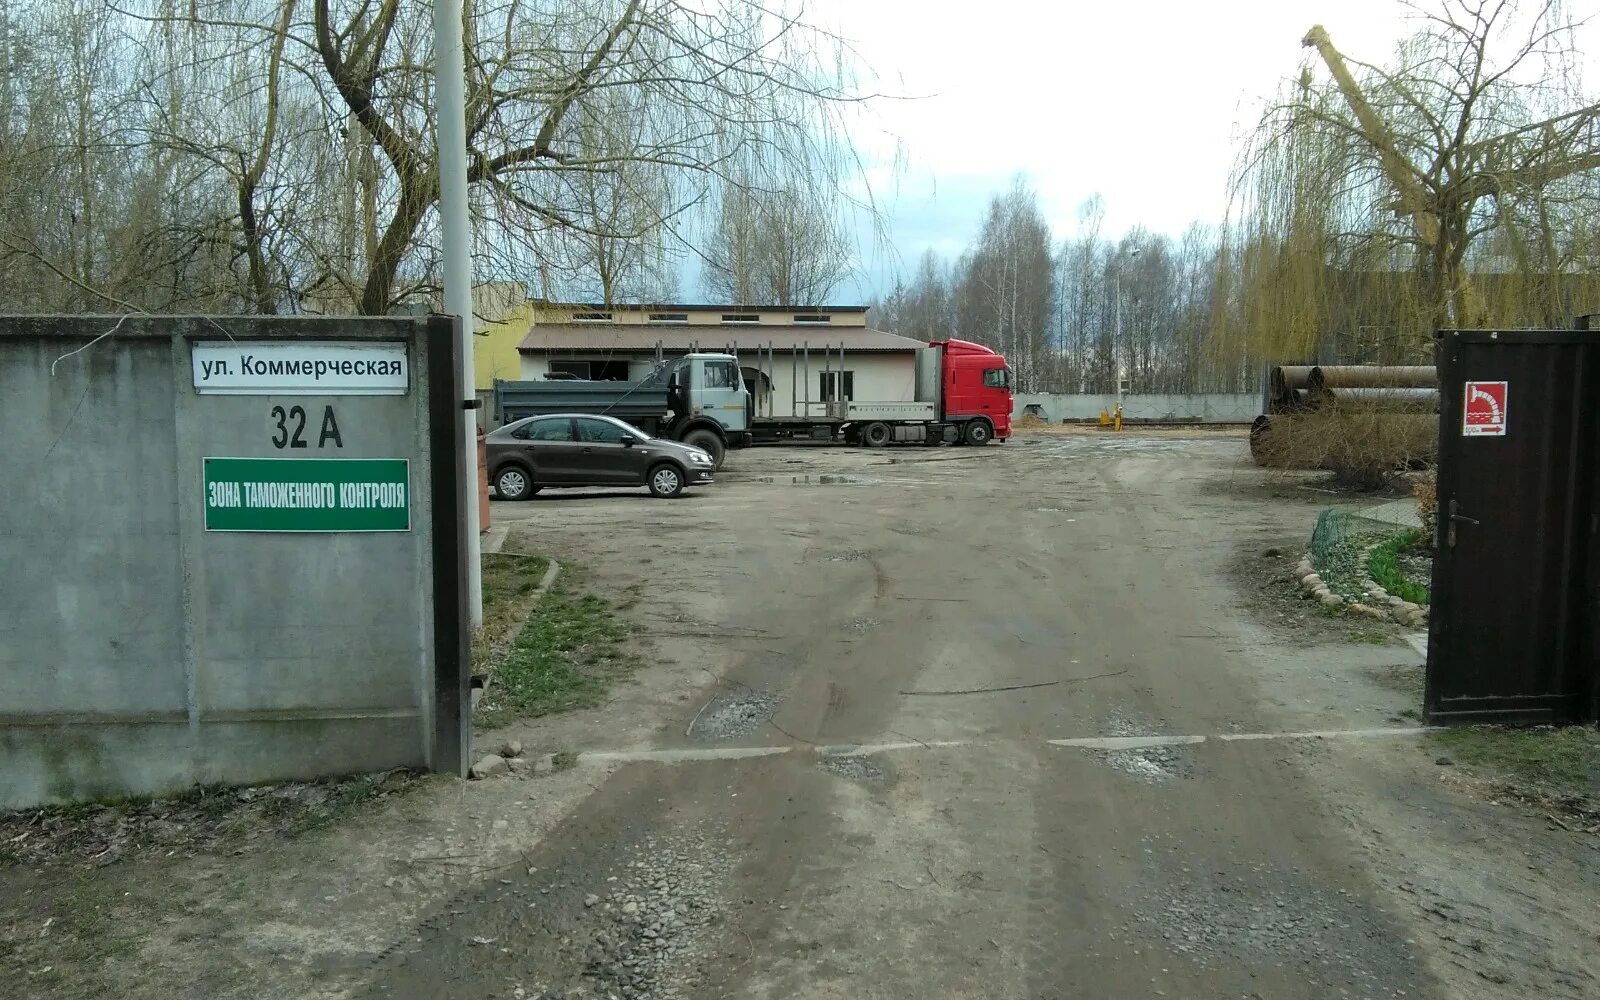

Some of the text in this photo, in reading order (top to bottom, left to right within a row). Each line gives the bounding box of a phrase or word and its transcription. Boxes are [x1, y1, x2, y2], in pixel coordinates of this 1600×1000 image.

[201, 355, 402, 381] ул. Коммерческая
[271, 405, 343, 449] 32 А
[208, 481, 405, 508] ЗОНА ТАМОЖЕННОГО КОНТРОЛЯ
